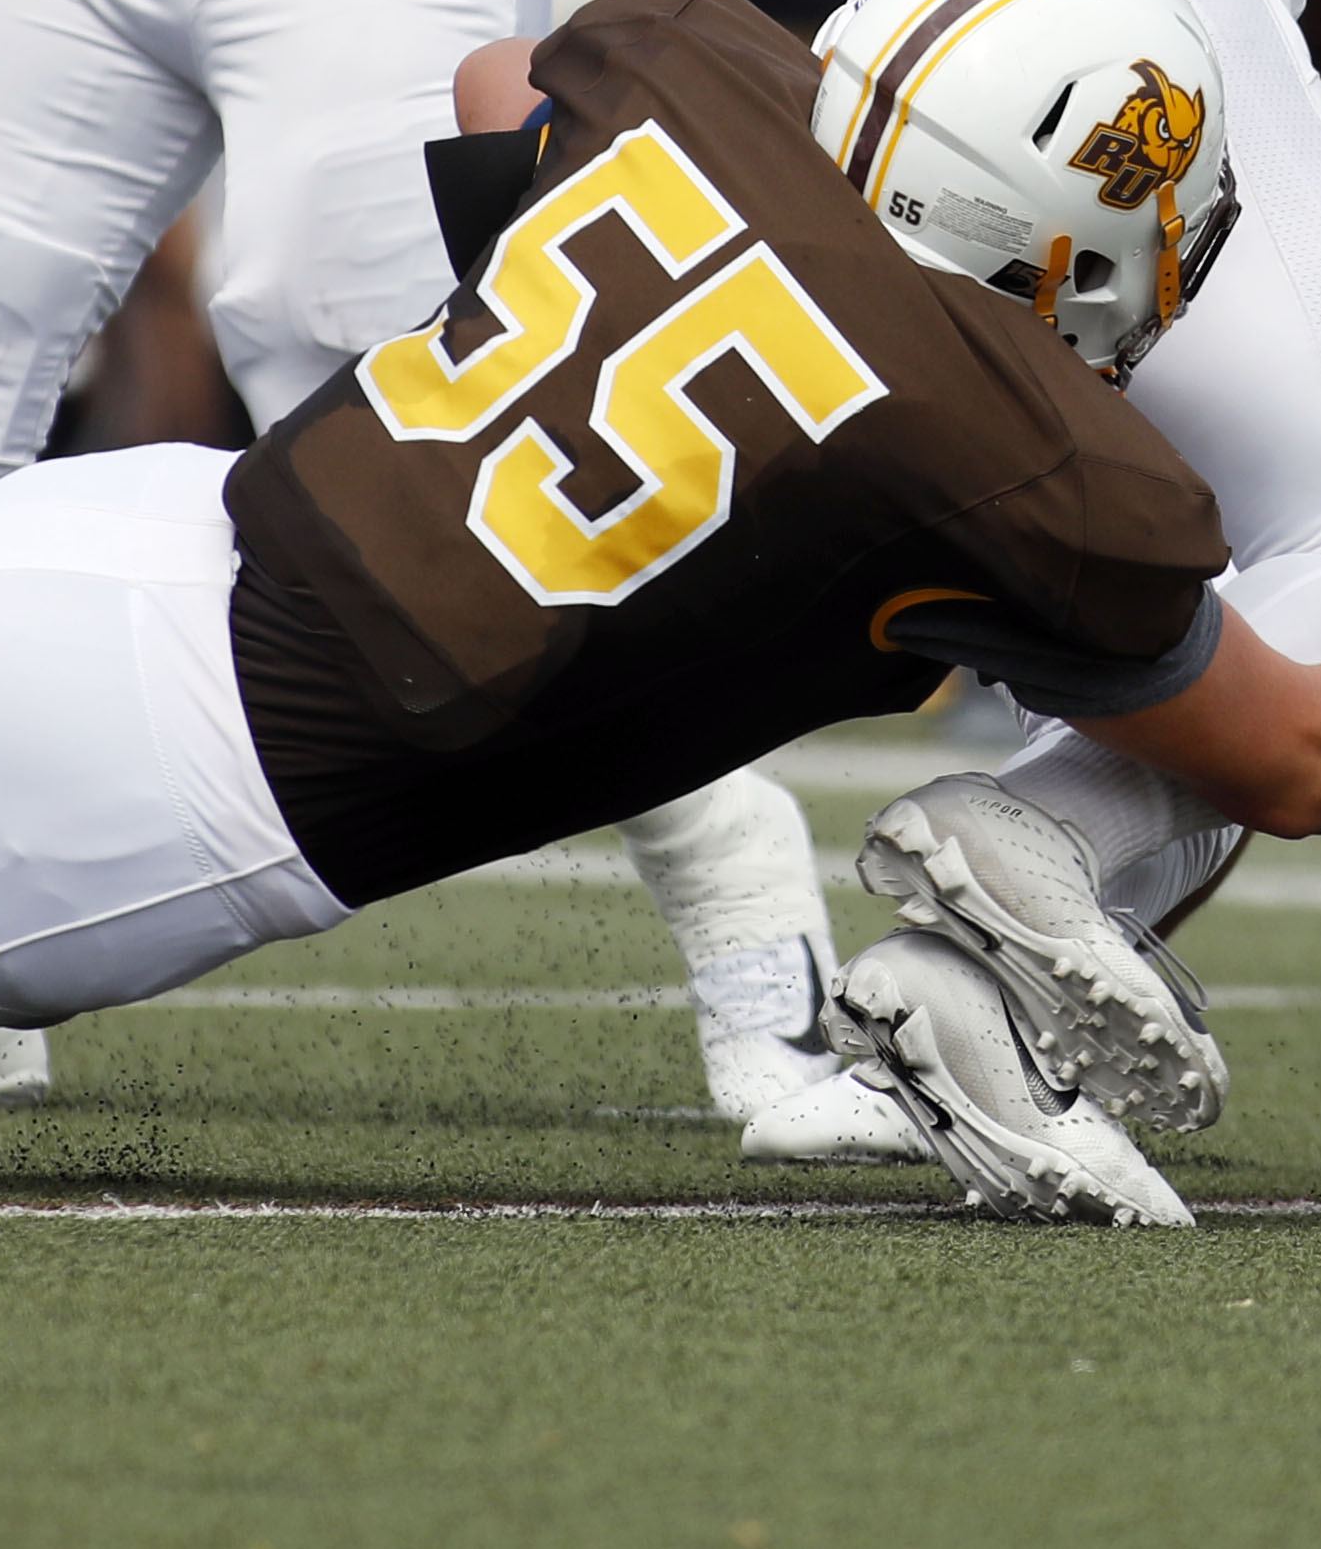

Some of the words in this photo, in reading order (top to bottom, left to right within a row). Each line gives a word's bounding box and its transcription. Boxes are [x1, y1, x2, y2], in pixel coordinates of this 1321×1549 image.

[1068, 123, 1162, 210] RU
[889, 190, 925, 226] 55
[354, 118, 890, 607] 55
[968, 797, 1023, 818] VAPOR
